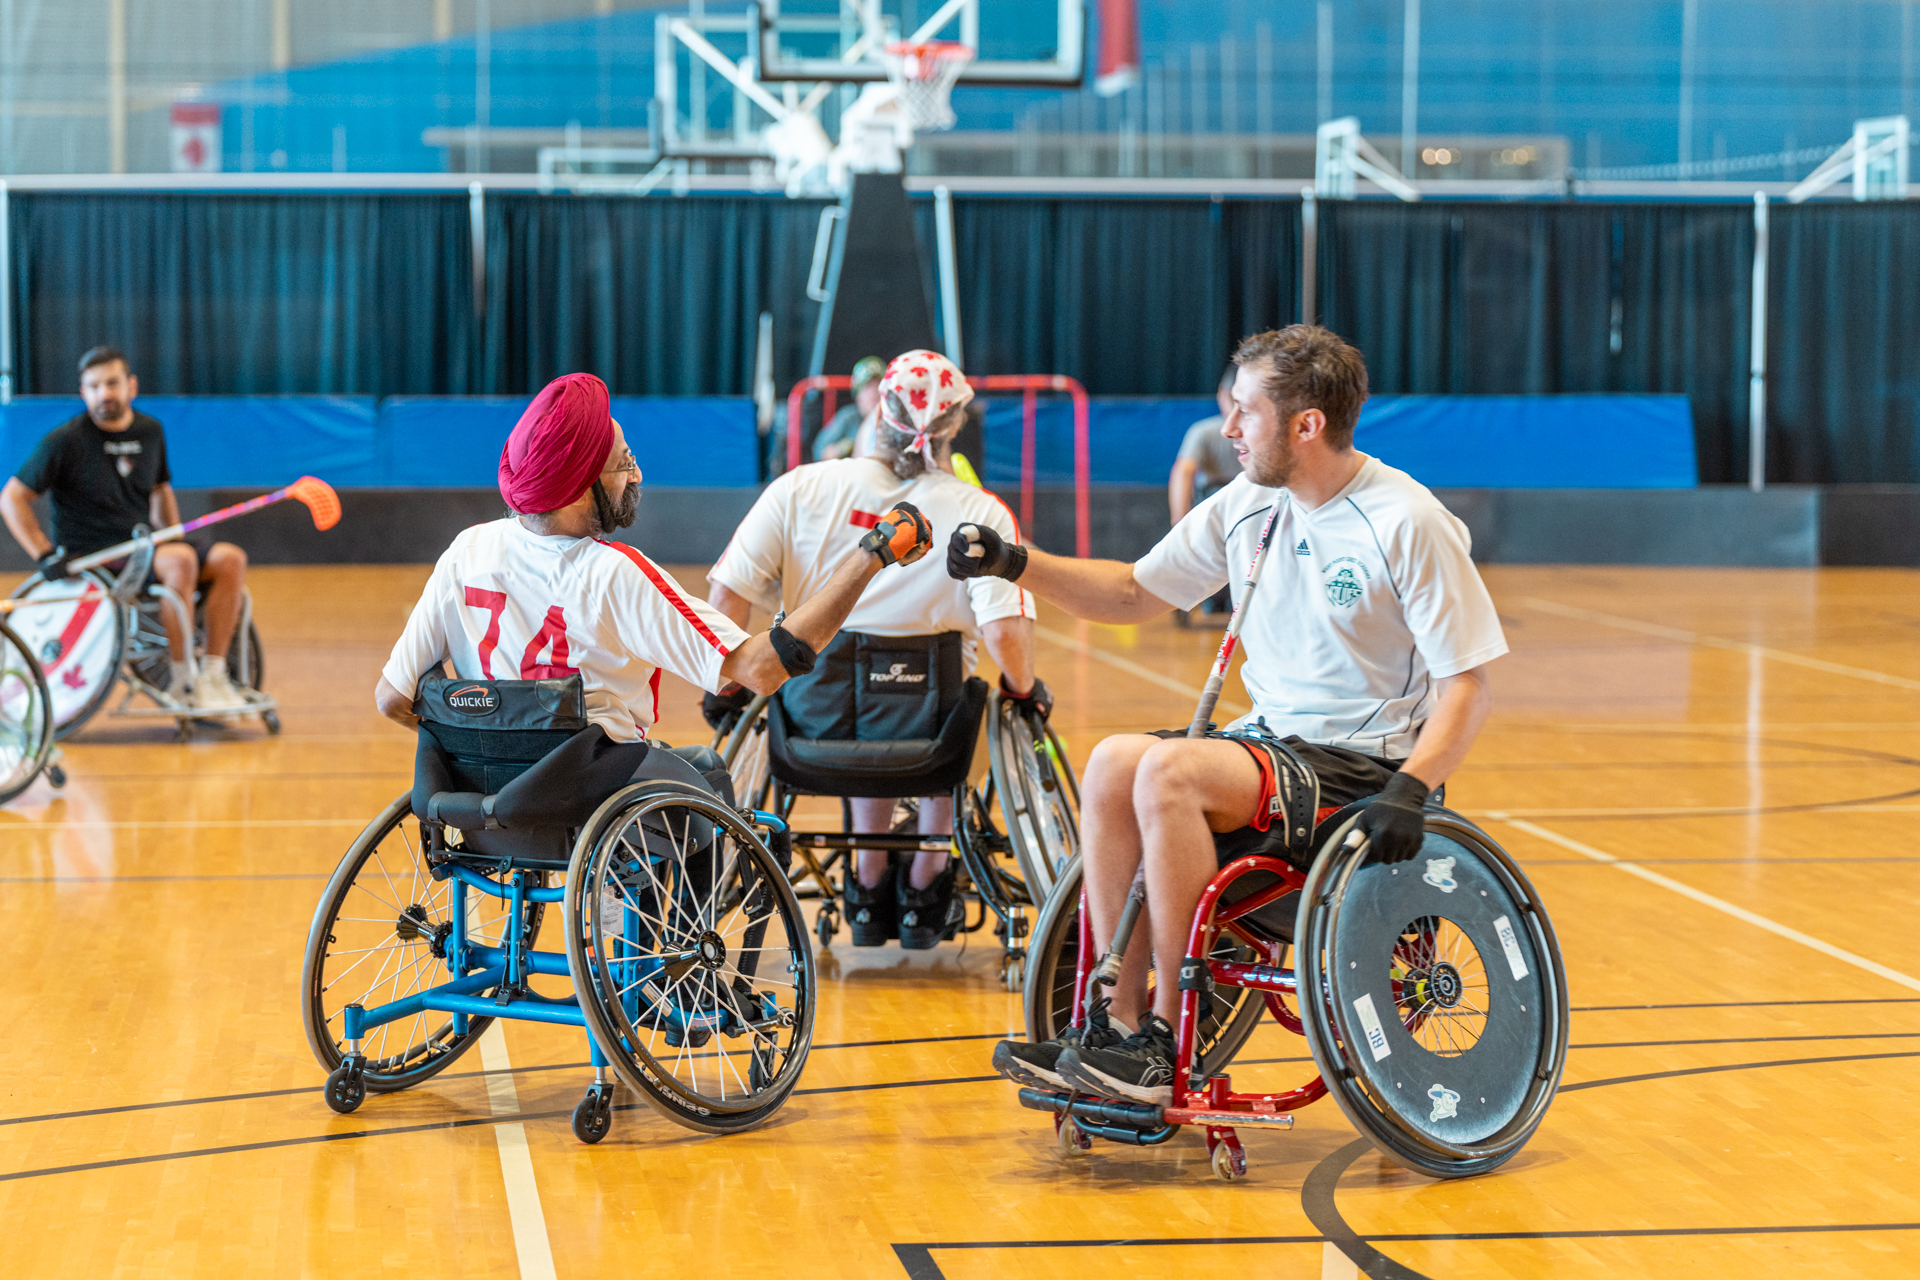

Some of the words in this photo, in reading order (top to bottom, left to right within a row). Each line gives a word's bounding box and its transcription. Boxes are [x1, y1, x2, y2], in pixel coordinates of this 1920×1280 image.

[464, 585, 580, 681] 74
[869, 672, 894, 682] TOP
[895, 673, 924, 683] END
[449, 696, 494, 708] QUICKIE
[1368, 1027, 1385, 1050] BC
